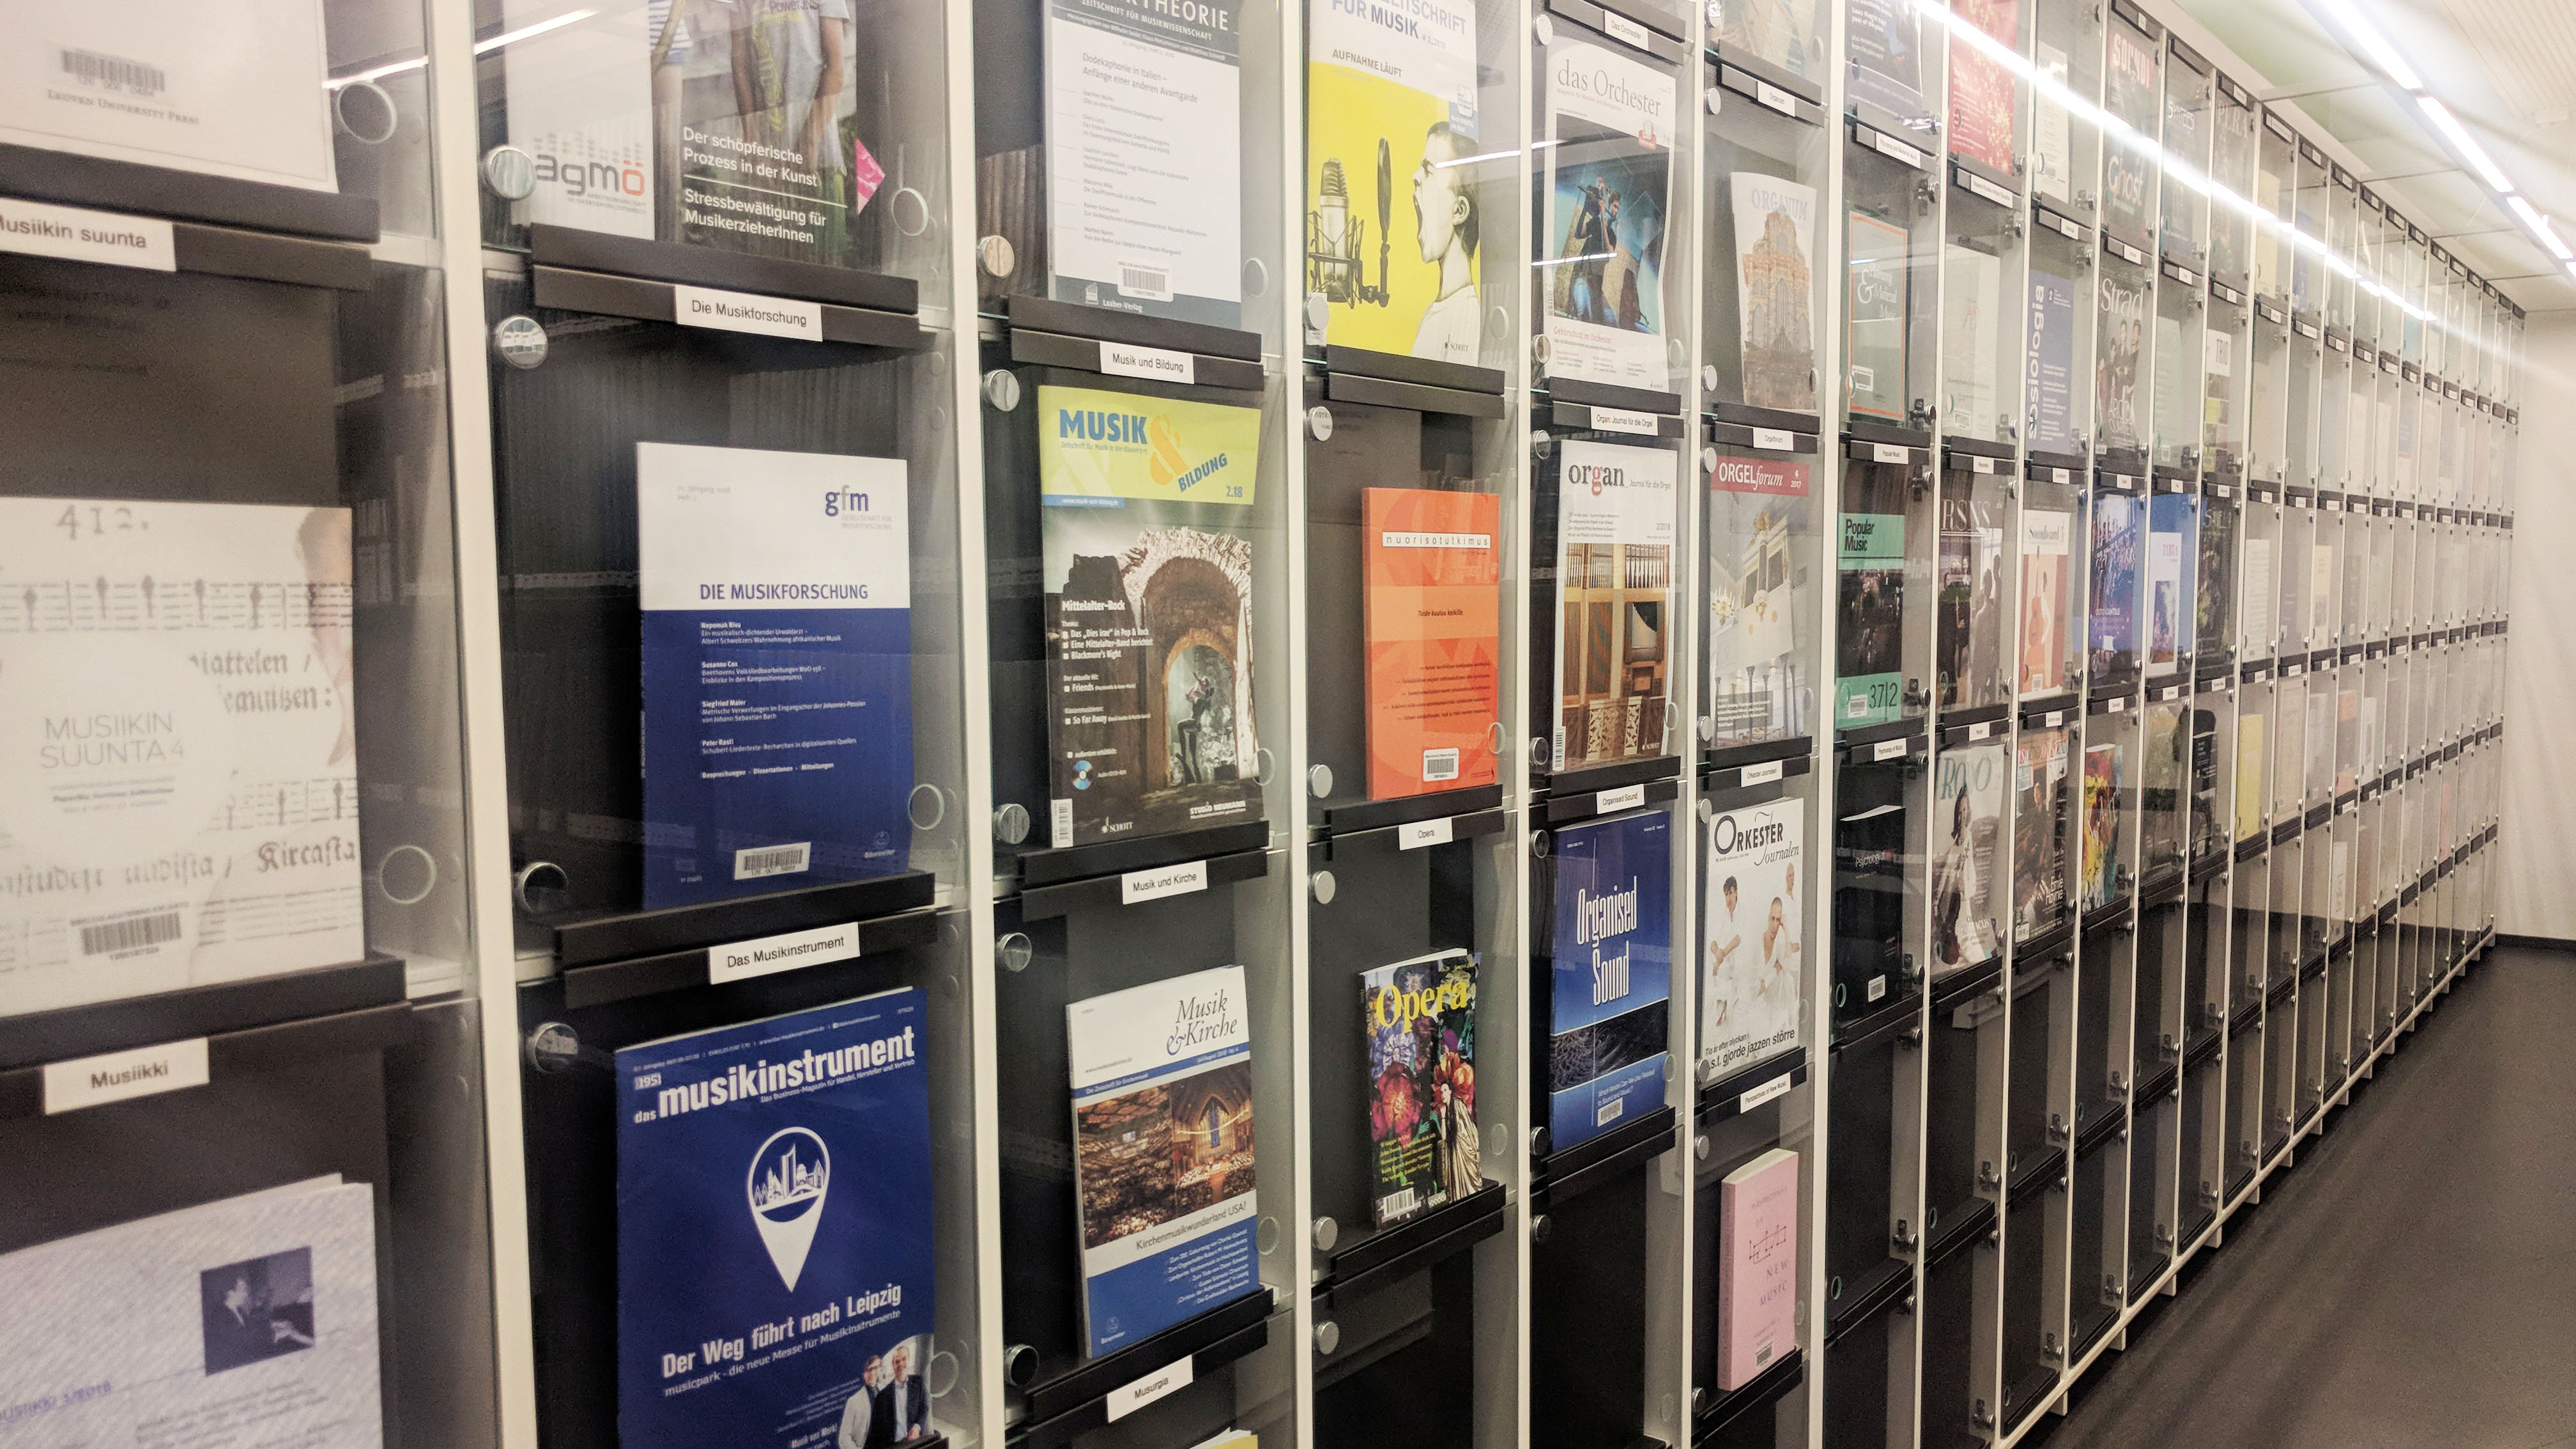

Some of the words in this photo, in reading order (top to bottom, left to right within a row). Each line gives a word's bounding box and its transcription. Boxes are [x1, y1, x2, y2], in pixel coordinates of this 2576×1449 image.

[1126, 10, 1139, 20] FÜR
[1142, 15, 1212, 40] MUSIKWISSENSCHAFT
[1371, 4, 1419, 39] MUSIK
[1083, 53, 1131, 73] Dodekaphonie
[1133, 66, 1139, 76] in
[1141, 68, 1161, 81] Italien
[1333, 49, 1379, 70] AUFNAHME
[1381, 61, 1402, 77] LÄUFT
[1083, 66, 1112, 83] Anfänge
[1114, 75, 1130, 86] einer
[1132, 80, 1158, 94] anderen
[1160, 86, 1198, 103] Avantgarde
[1558, 59, 1588, 91] das
[1594, 70, 1661, 118] Orchester
[97, 97, 165, 121] UNIVERSITY
[684, 127, 709, 144] Der
[712, 131, 804, 164] schöpferische
[536, 154, 645, 196] agmö
[684, 147, 737, 169] Prozess
[740, 158, 753, 172] in
[756, 162, 778, 178] der
[781, 167, 818, 187] Kunst
[685, 188, 806, 225] Stressbewältigung
[809, 211, 827, 227] für
[81, 227, 148, 249] suunta
[685, 211, 815, 244] MusikerzieherInnen
[692, 300, 712, 314] Die
[716, 301, 807, 327] Musikforschung
[2101, 279, 2143, 319] Strad
[1112, 353, 1137, 366] Musik
[1138, 357, 1154, 368] und
[1156, 359, 1183, 373] Bildung
[1059, 409, 1148, 445] MUSIK
[1178, 452, 1228, 493] BILDUNG
[1568, 463, 1624, 496] organ
[1719, 462, 1782, 491] ORGELforum
[825, 485, 869, 517] gfm
[1226, 486, 1243, 498] 2.18
[1844, 535, 1868, 551] Music
[1846, 519, 1874, 537] Popular
[700, 584, 725, 599] DIE
[731, 585, 868, 599] MUSIKFORSCHUNG
[1062, 599, 1125, 611] Mittelalter-Rock
[45, 711, 172, 740] MUSIIKIN
[1092, 715, 1107, 724] Away
[41, 740, 167, 769] SUUNTA
[1625, 792, 1637, 801] Sound
[1418, 829, 1435, 840] Opera
[1754, 809, 1799, 866] Journalen
[1133, 881, 1155, 892] Musik
[1158, 877, 1172, 887] und
[1174, 873, 1197, 884] Kirche
[1577, 875, 1637, 947] Organised
[727, 954, 750, 968] Das
[753, 937, 845, 963] Musikinstrument
[1593, 940, 1629, 1006] Sound
[1176, 989, 1227, 1023] Musik
[1376, 979, 1468, 1033] Opera
[1747, 1038, 1770, 1057] jazzen
[1772, 1029, 1795, 1045] större
[91, 1060, 169, 1089] Musiikki
[634, 1110, 657, 1124] das
[659, 1025, 916, 1119] musikinstrument
[663, 1353, 694, 1378] Der
[703, 1338, 744, 1365] Weg
[751, 1316, 795, 1350] führt
[801, 1302, 840, 1333] nach
[848, 1283, 901, 1317] Leipzig
[665, 1370, 721, 1397] musicpark
[728, 1365, 744, 1377] die
[746, 1356, 770, 1370] neue
[772, 1344, 802, 1361] Messe
[804, 1337, 818, 1349] für
[820, 1309, 901, 1345] Musikinstrumente
[1135, 1376, 1169, 1400] Musurgia
